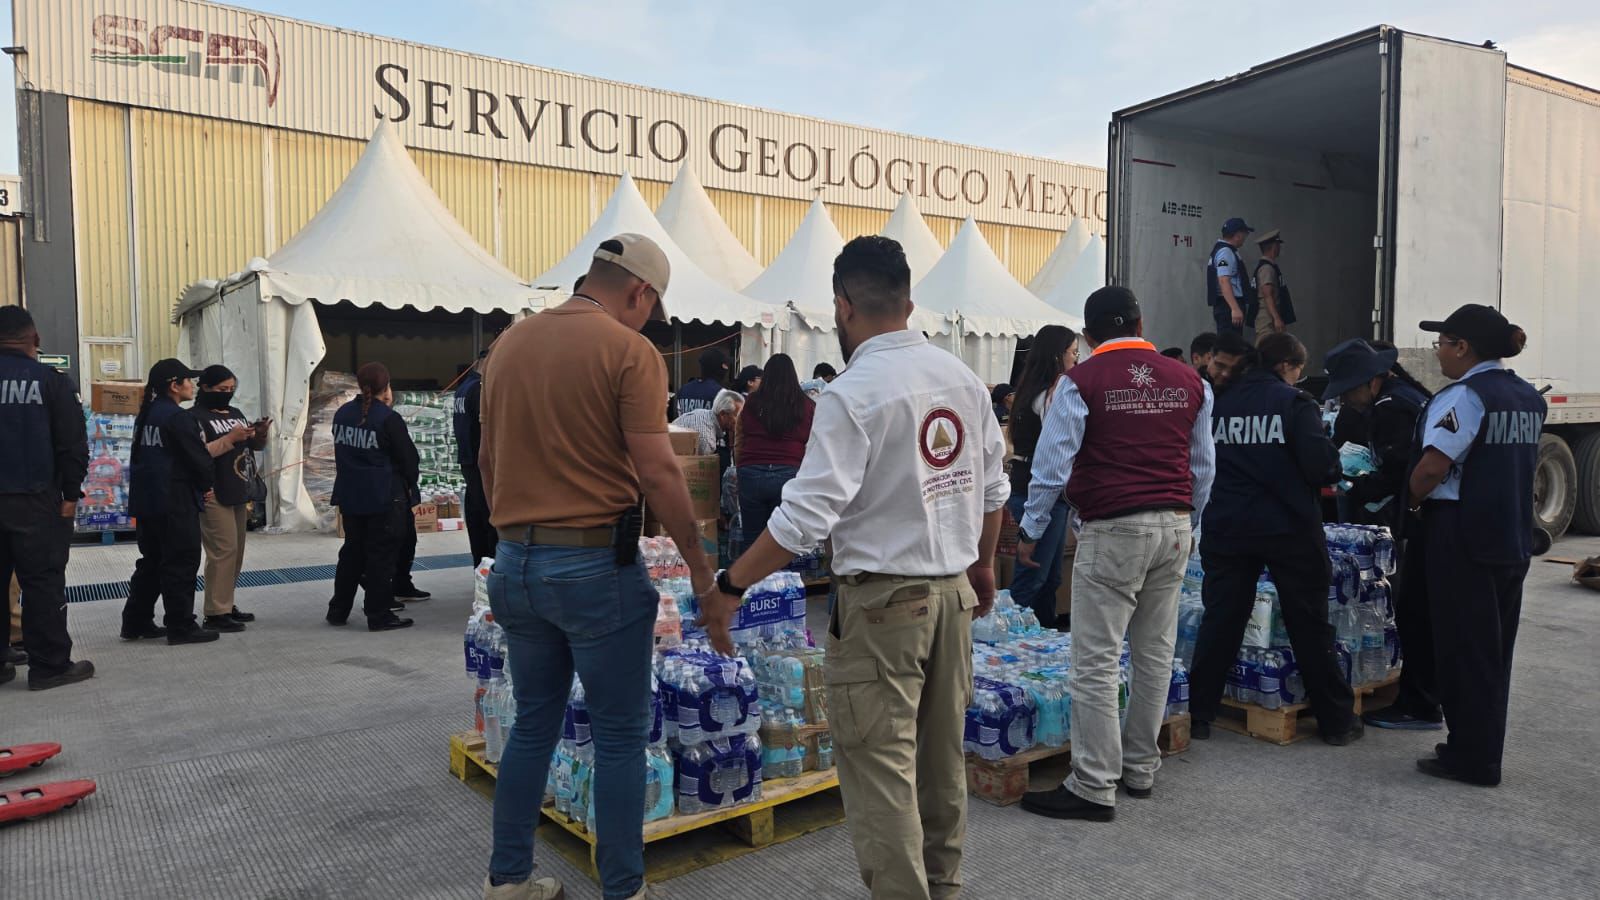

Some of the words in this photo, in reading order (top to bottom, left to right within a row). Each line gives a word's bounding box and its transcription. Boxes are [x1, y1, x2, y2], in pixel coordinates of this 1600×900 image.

[373, 63, 688, 163] SERVICIO
[709, 122, 989, 206] GEOLÓGICO
[1162, 201, 1203, 218] AIR-RIDE
[1104, 388, 1189, 404] HIDALGO
[1211, 415, 1285, 444] ARINA
[750, 597, 781, 613] BURST
